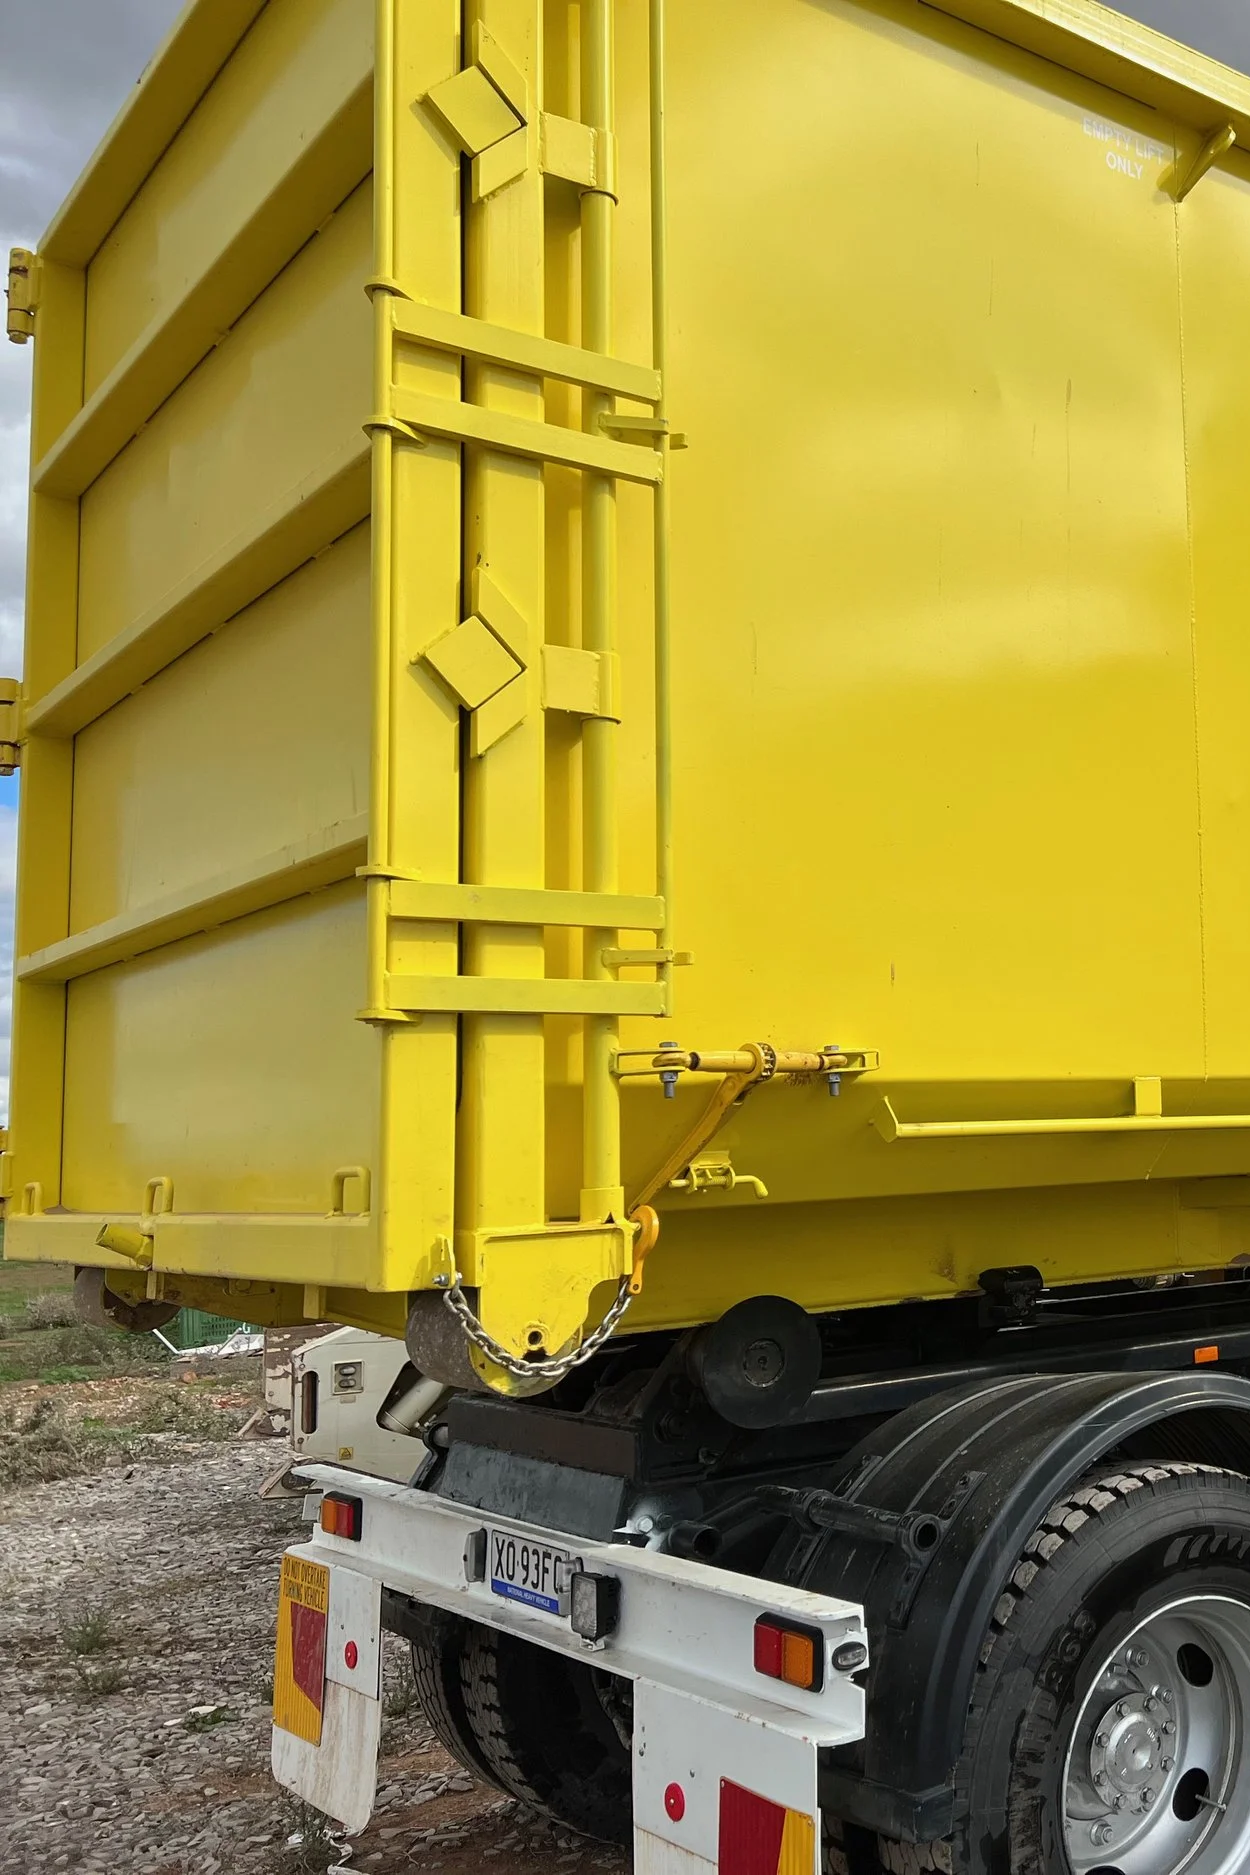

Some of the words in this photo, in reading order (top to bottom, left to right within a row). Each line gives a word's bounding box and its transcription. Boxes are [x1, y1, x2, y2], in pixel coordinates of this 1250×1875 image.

[1083, 117, 1131, 151] EMPTY
[1135, 139, 1164, 165] LIFT
[1106, 151, 1143, 180] ONLY
